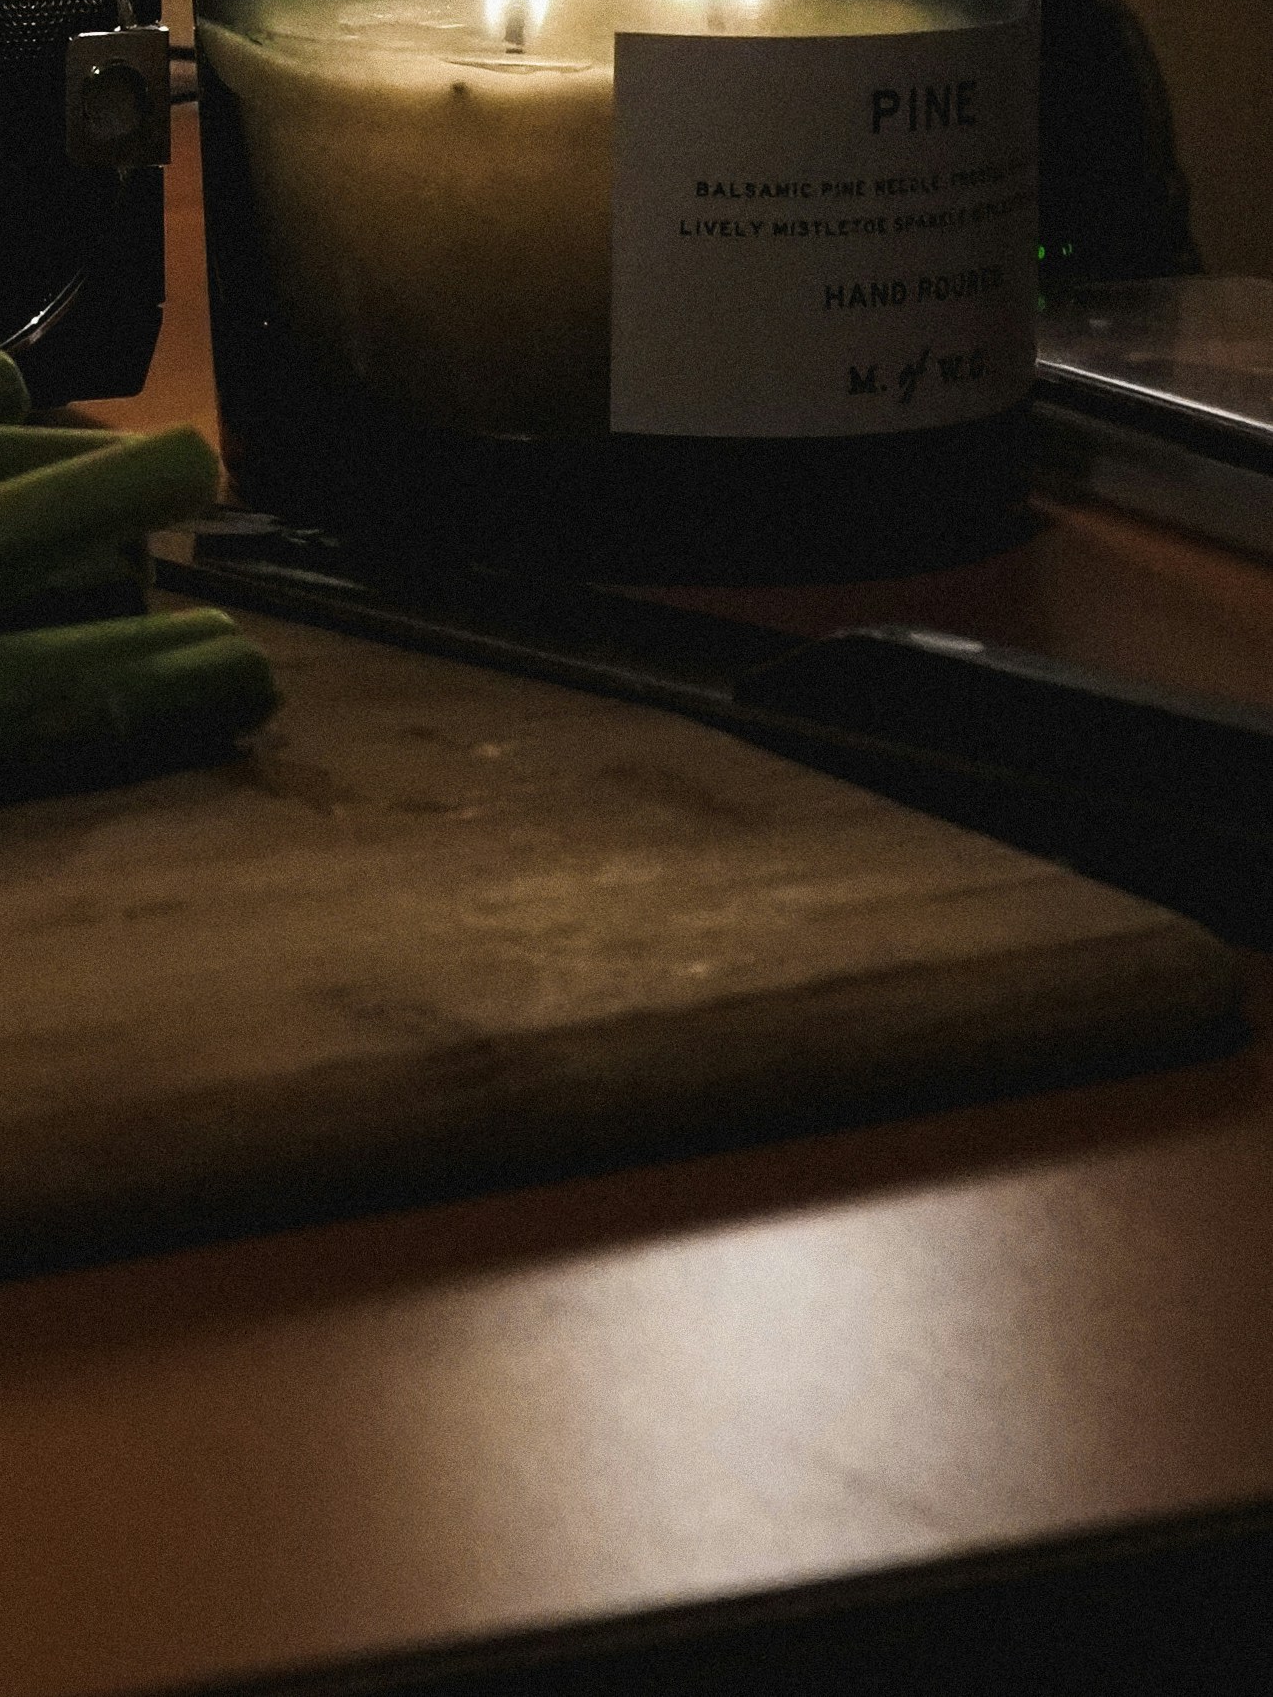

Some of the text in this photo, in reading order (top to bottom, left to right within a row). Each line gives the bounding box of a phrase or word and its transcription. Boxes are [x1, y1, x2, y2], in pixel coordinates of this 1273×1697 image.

[870, 79, 977, 134] PINE
[695, 179, 812, 199] BALSAMIC
[821, 179, 865, 198] PINE
[678, 218, 764, 237] LIVELY
[772, 217, 887, 237] MISTLETOE
[824, 280, 909, 309] HAND
